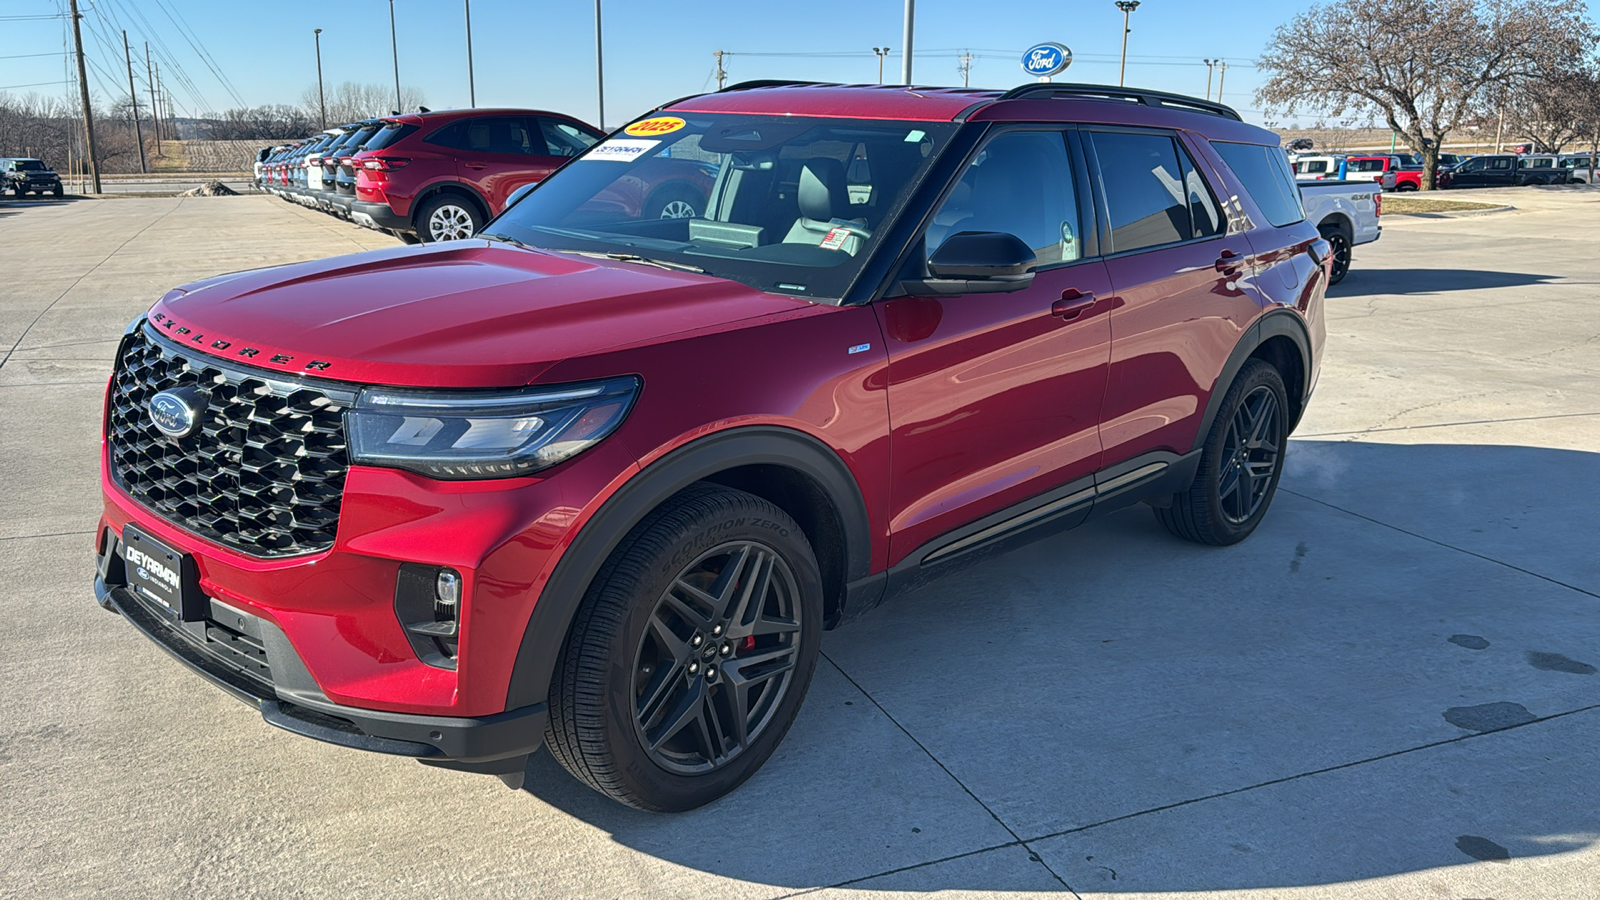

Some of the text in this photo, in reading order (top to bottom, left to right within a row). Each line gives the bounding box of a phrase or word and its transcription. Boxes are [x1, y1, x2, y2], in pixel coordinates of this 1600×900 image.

[1028, 49, 1056, 70] Ford
[628, 121, 681, 132] 2025
[153, 312, 332, 372] EXPLORER
[154, 400, 180, 428] Ford
[662, 517, 746, 576] SCORPION
[751, 517, 790, 538] ZERO
[126, 545, 180, 590] DEYARMAN
